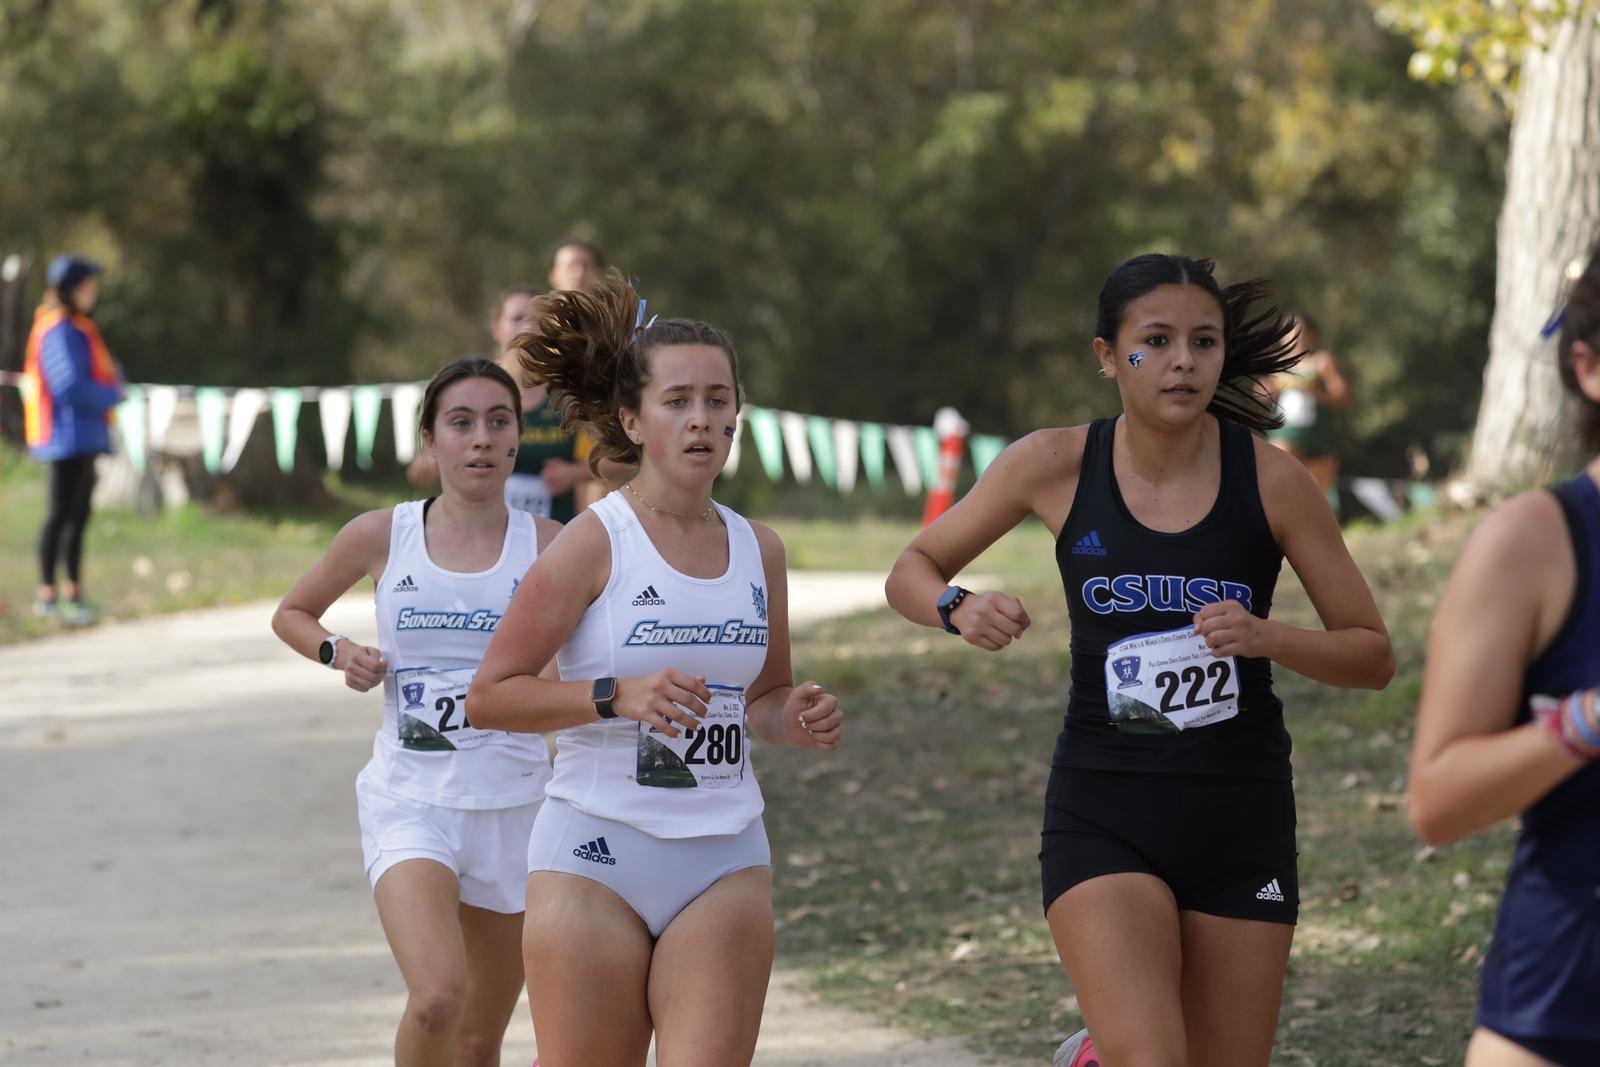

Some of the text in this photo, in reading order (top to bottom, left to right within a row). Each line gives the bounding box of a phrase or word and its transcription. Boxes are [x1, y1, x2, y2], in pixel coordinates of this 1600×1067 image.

[1072, 545, 1107, 556] adidas
[392, 585, 419, 593] adidas
[1082, 574, 1252, 615] CSUSB
[632, 597, 666, 607] adidas
[397, 608, 468, 631] SONOMA
[622, 618, 720, 647] SONOMA
[1155, 660, 1235, 714] 222
[684, 723, 741, 765] 280
[573, 848, 617, 866] adidas
[1255, 891, 1285, 902] adidas
